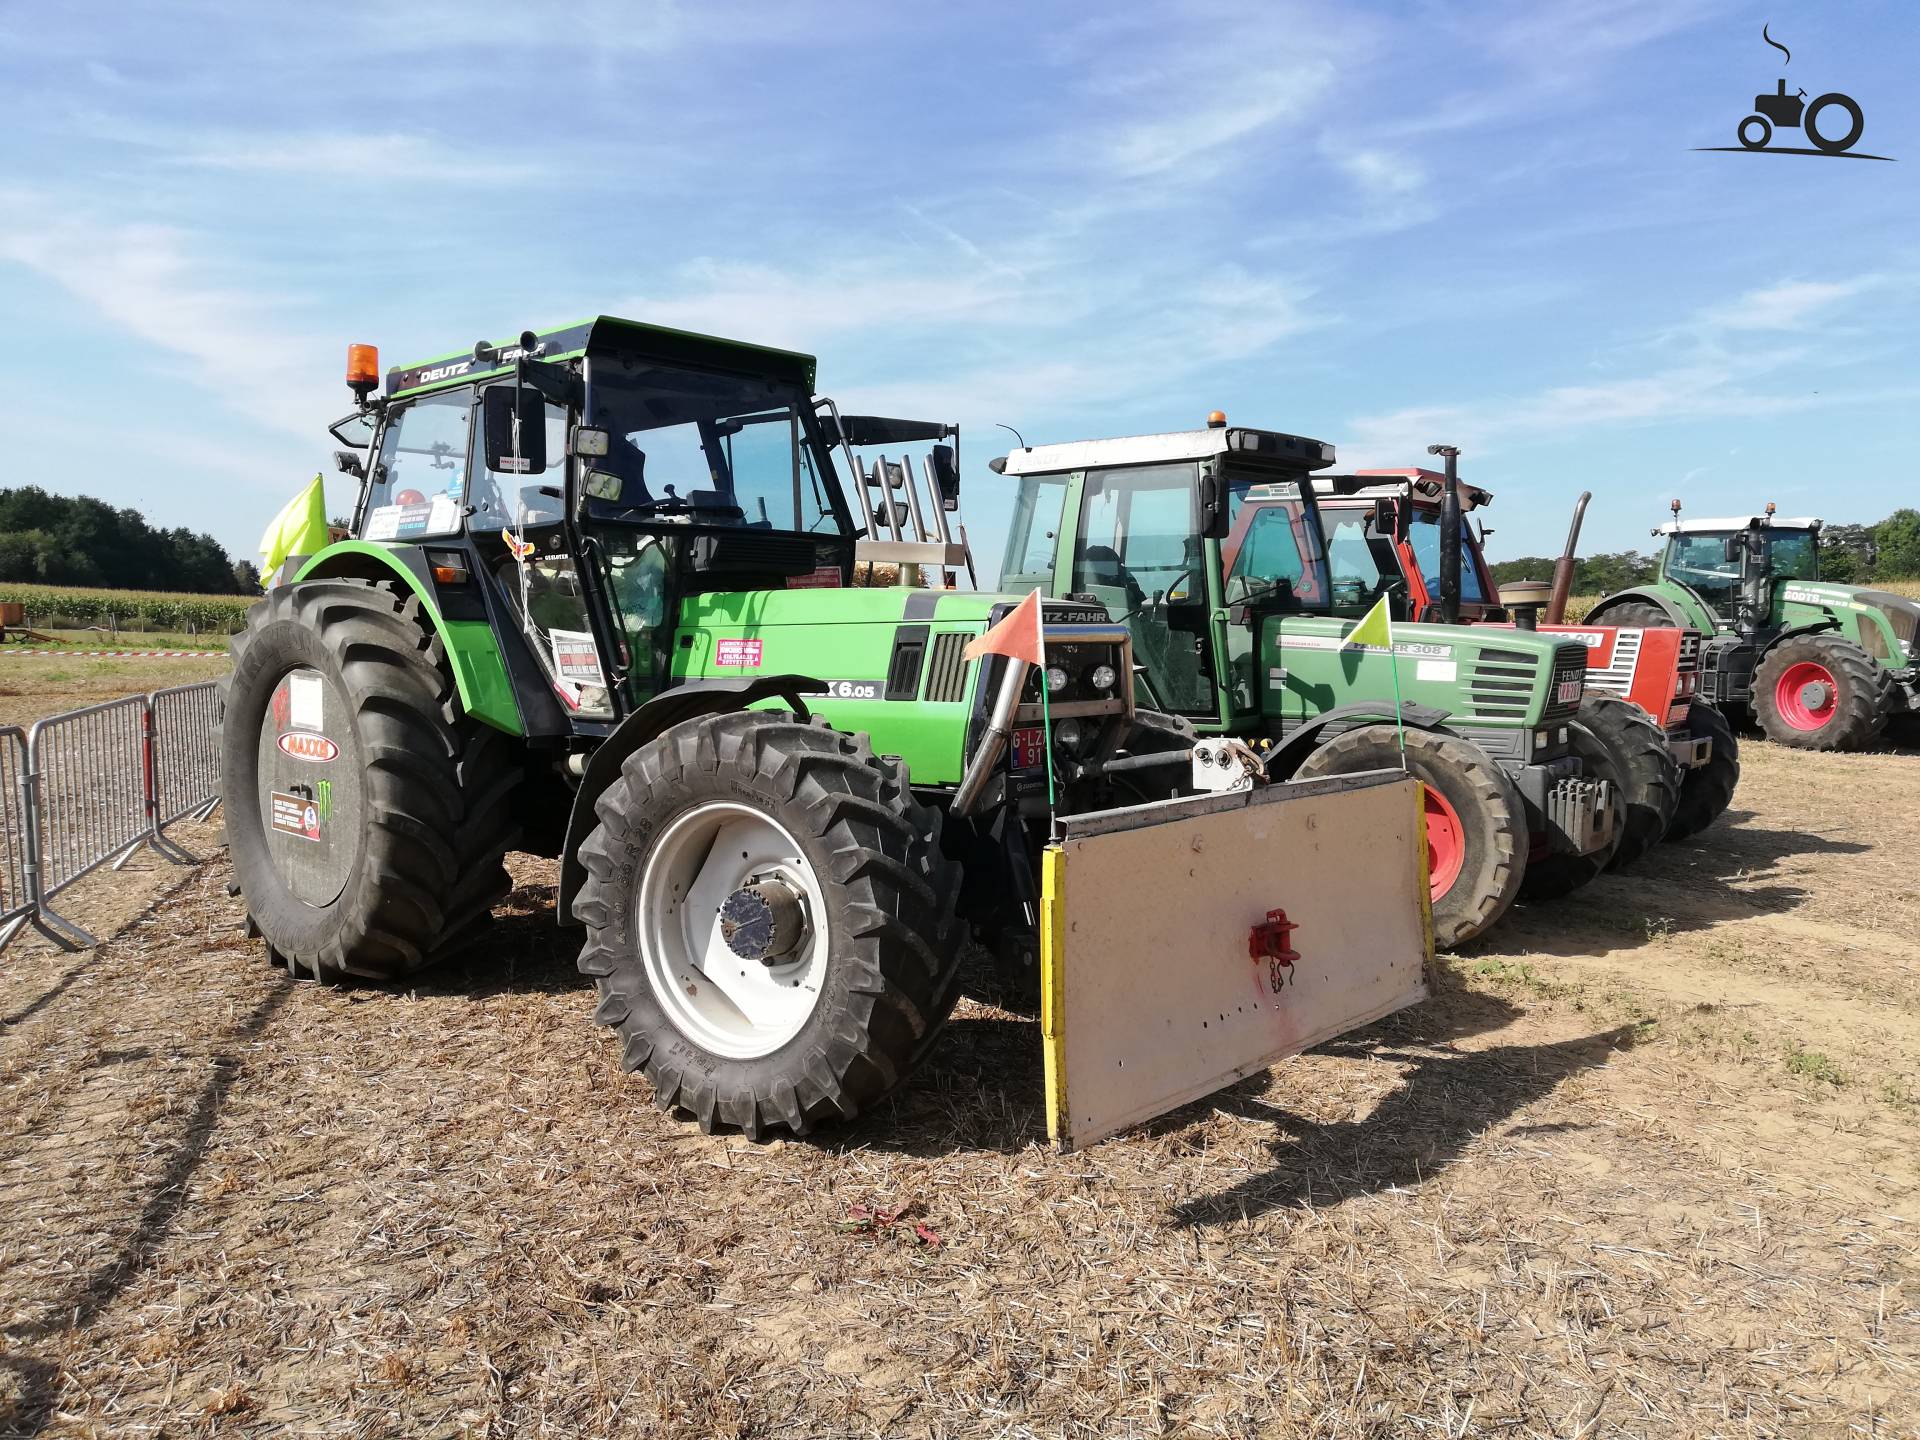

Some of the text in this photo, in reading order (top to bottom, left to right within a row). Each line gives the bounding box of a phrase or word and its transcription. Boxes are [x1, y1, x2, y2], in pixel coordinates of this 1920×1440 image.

[420, 361, 471, 384] DEUTZ
[544, 553, 569, 561] GESLOTEN
[1784, 590, 1820, 604] GODTS
[1043, 612, 1107, 623] TZ-FAHR
[1414, 645, 1443, 655] 308
[1562, 669, 1582, 681] FENDT
